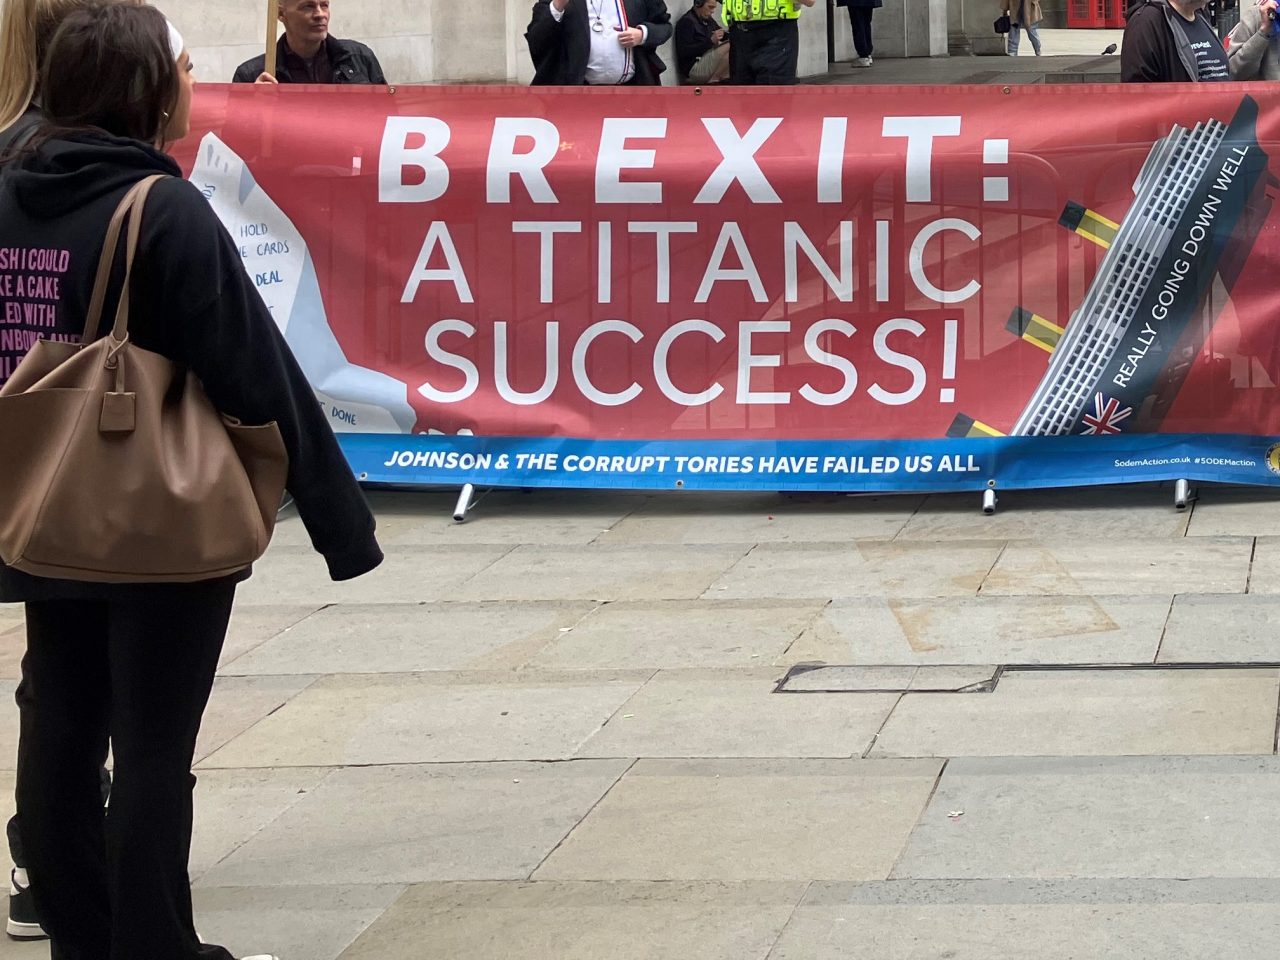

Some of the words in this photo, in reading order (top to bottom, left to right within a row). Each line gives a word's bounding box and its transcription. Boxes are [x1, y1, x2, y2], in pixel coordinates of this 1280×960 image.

[378, 116, 1009, 203] BREXIT:
[240, 223, 268, 238] HOLD
[256, 240, 290, 256] CARDS
[400, 220, 475, 303] A
[512, 217, 982, 303] TITANIC
[28, 248, 70, 273] COULD
[1112, 322, 1157, 388] REALLY
[1151, 258, 1190, 320] GOING
[1182, 194, 1222, 256] DOWN
[1212, 144, 1249, 191] WELL
[16, 276, 25, 297] A
[27, 276, 60, 300] CAKE
[255, 270, 283, 287] DEAL
[23, 303, 56, 327] WITH
[417, 318, 958, 406] SUCCESS!
[331, 406, 357, 426] DONE
[384, 450, 492, 470] JOHNSON
[494, 453, 509, 470] &
[515, 453, 558, 471] THE
[563, 454, 669, 473] CORRUPT
[674, 455, 753, 473] TORIES
[757, 456, 820, 473] HAVE
[822, 456, 900, 474] FAILED
[904, 455, 933, 473] US
[936, 454, 980, 472] ALL
[1114, 457, 1191, 467] SodemAction.co.uk
[1194, 457, 1256, 467] #SODEMaction
